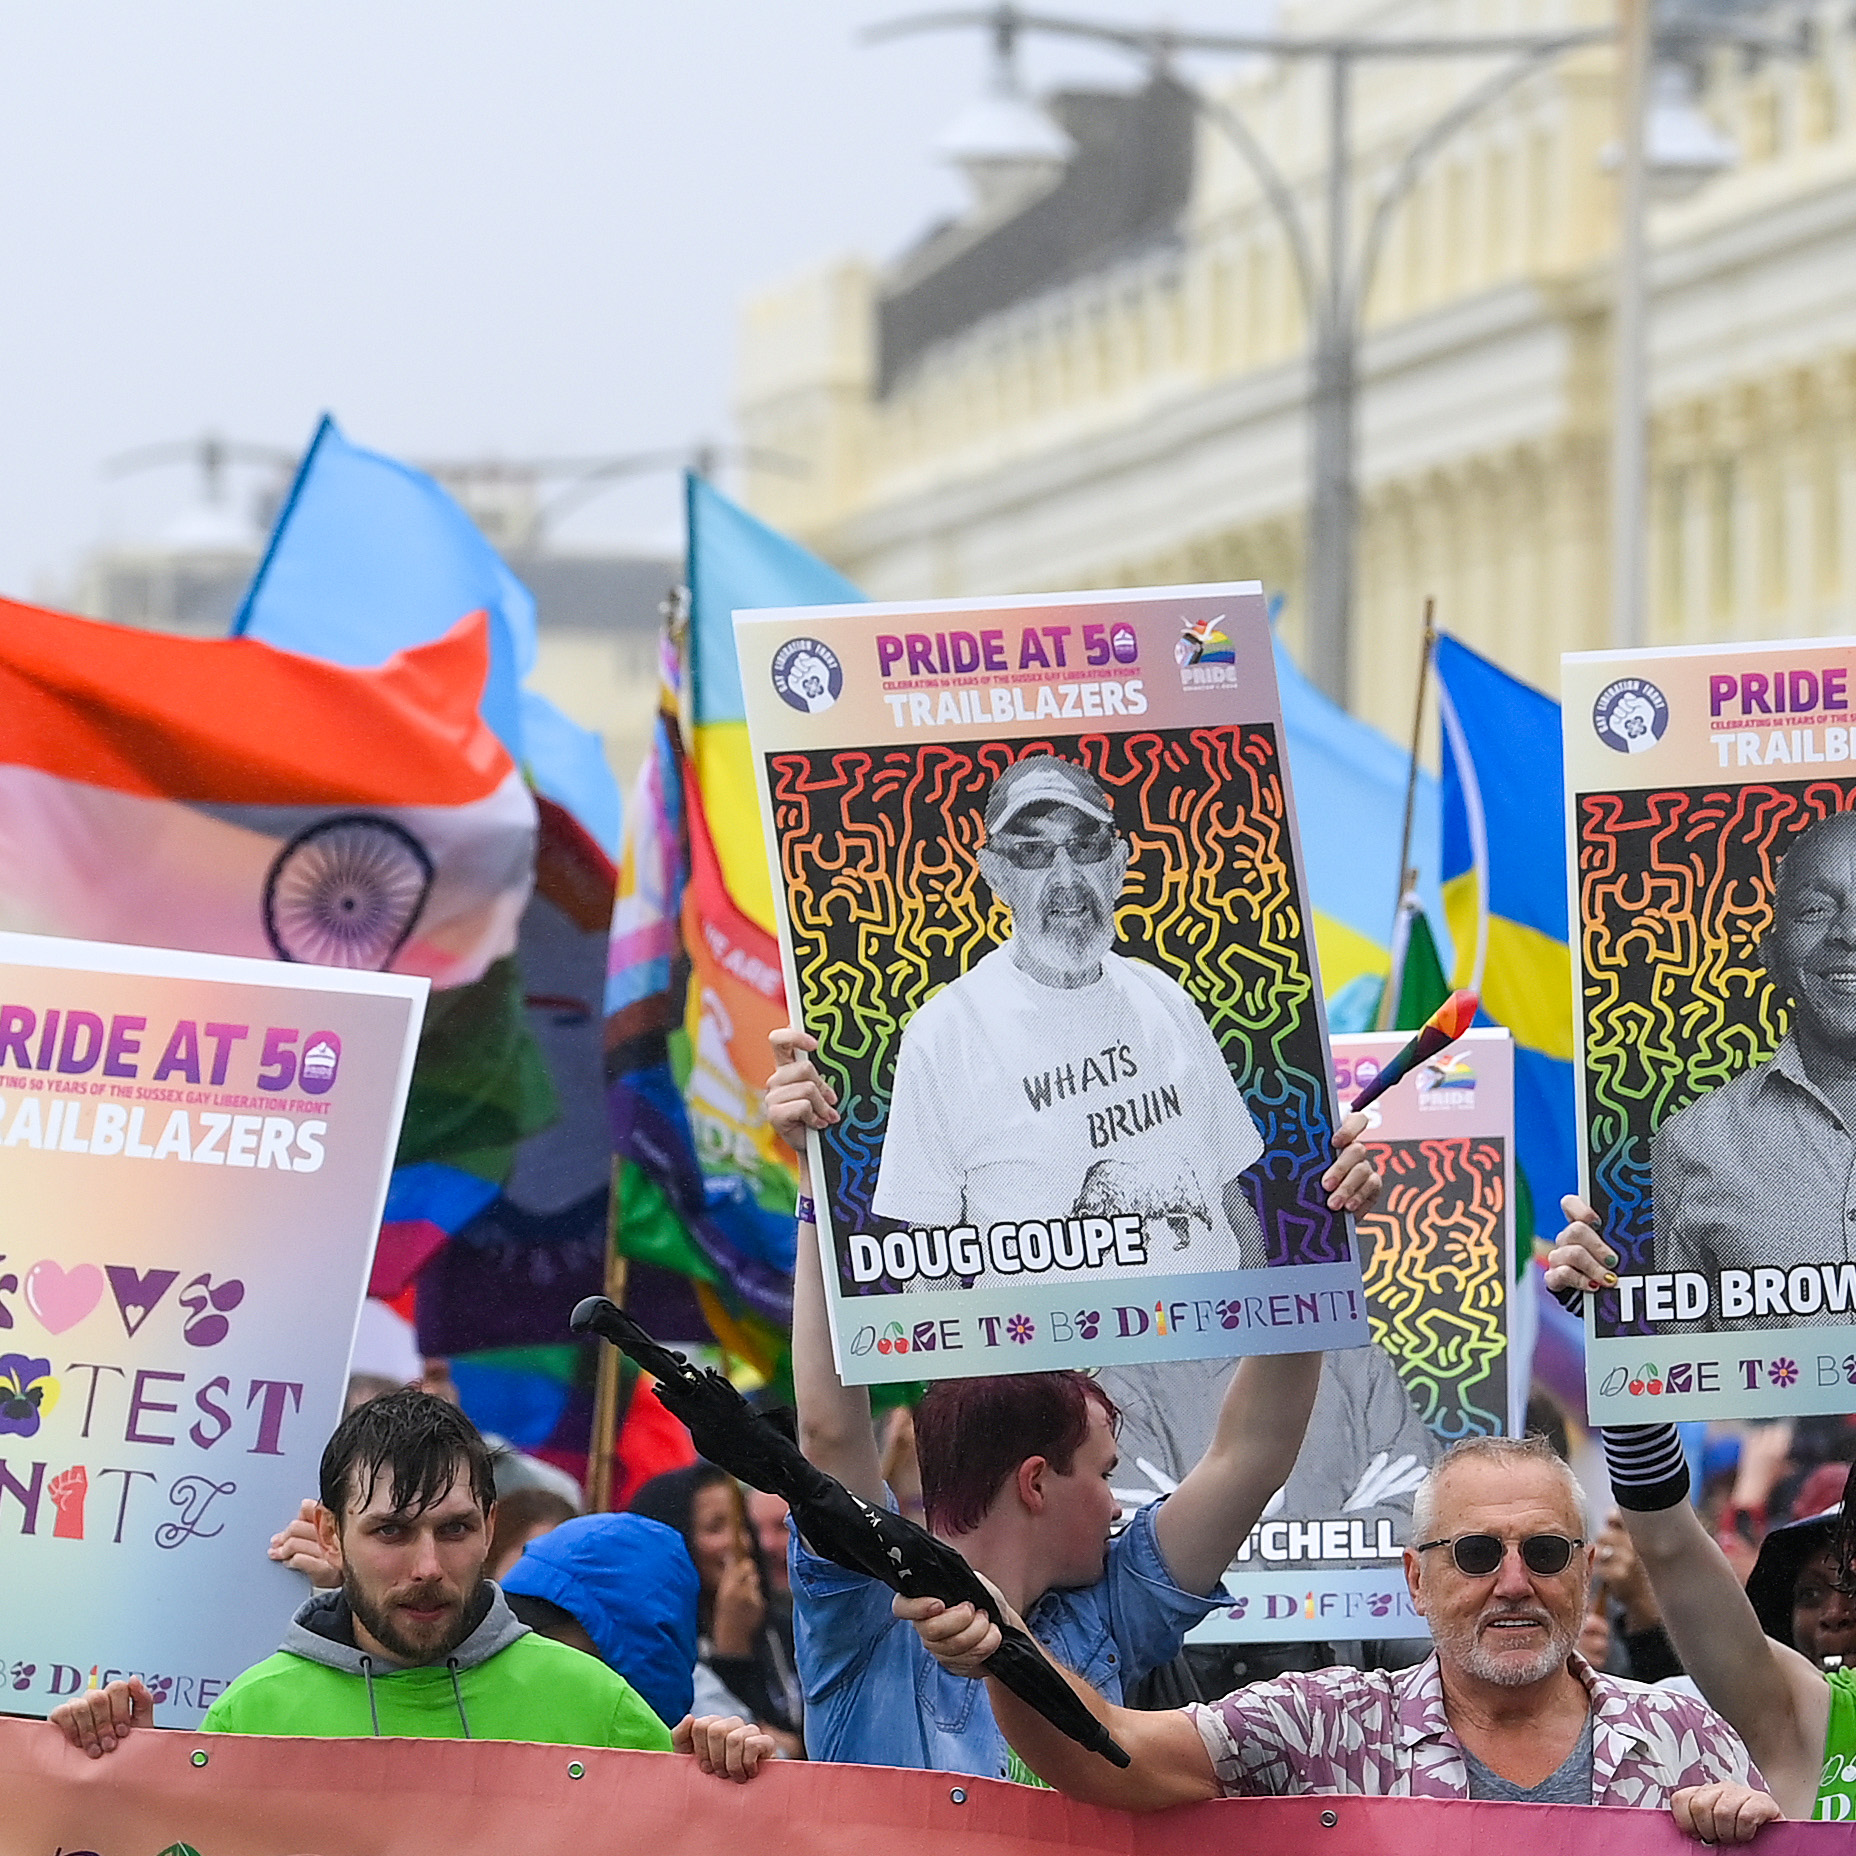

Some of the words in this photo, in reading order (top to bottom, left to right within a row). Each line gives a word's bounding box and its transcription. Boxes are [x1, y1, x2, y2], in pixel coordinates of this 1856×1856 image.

[876, 631, 1009, 677] PRIDE
[1018, 626, 1072, 672] AT
[1086, 622, 1139, 665] 50
[883, 680, 1148, 728] TRAILBLAZERS
[1709, 669, 1848, 717] PRIDE
[153, 1020, 249, 1086] AT
[256, 1026, 342, 1095] 50
[47, 1079, 87, 1095] YEARS
[90, 1083, 106, 1095] OF
[110, 1084, 133, 1098] THE
[136, 1087, 183, 1102] SUSSEX
[185, 1091, 210, 1104] GAY
[213, 1093, 287, 1111] LIBERATION
[288, 1099, 332, 1115] FRONT
[1087, 1086, 1182, 1150] BRUIN
[850, 1225, 982, 1284] DOUG
[991, 1215, 1145, 1273] COUPE
[1617, 1271, 1709, 1323] TED
